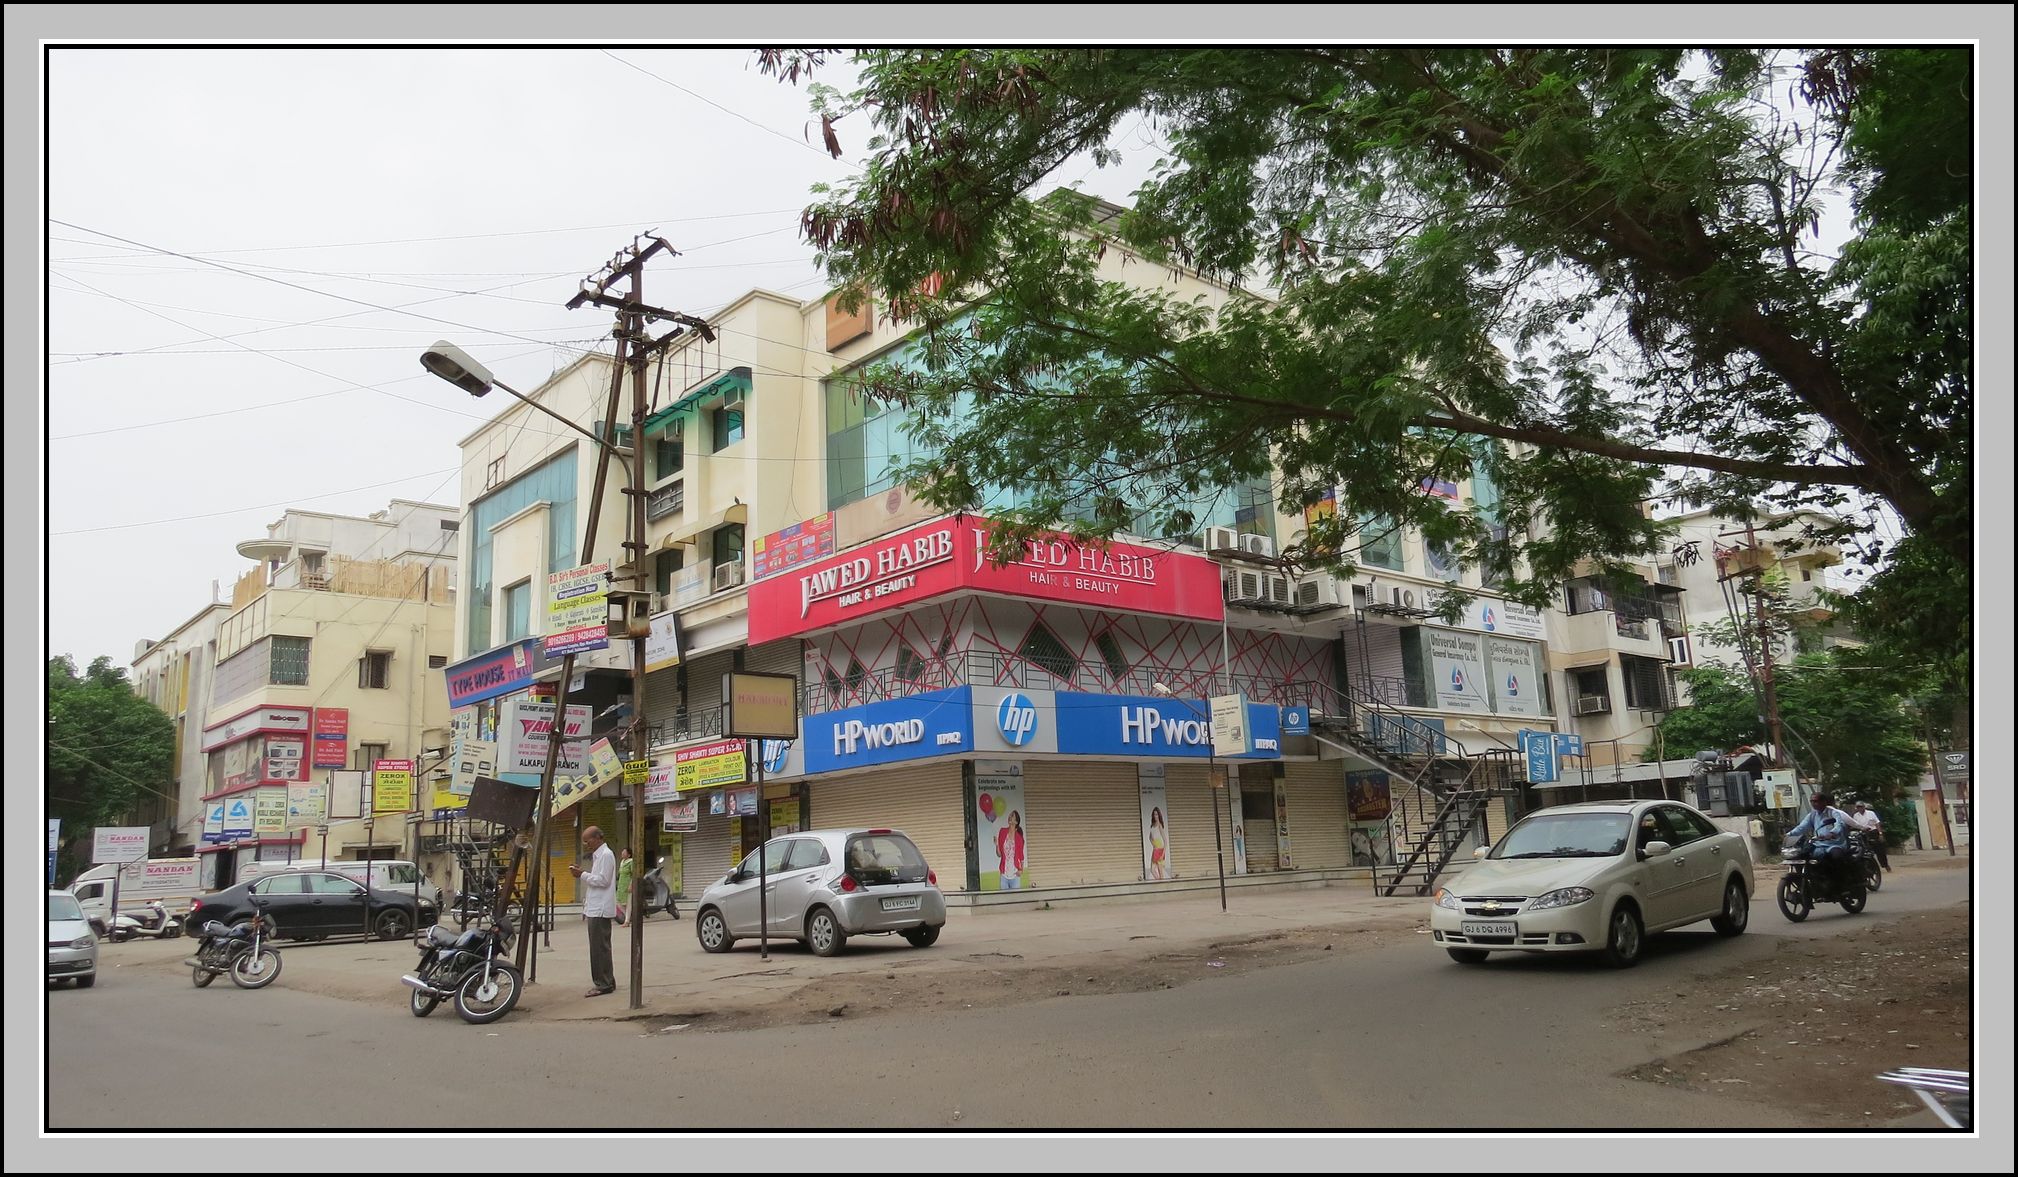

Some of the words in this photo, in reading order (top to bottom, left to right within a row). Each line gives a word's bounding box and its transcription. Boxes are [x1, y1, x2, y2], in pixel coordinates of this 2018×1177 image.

[972, 528, 1068, 573] JED
[1078, 546, 1157, 581] HABIB
[800, 558, 872, 619] JAWED
[877, 529, 954, 576] HABIB
[1029, 571, 1058, 586] HAIR
[1062, 575, 1071, 588] &
[1075, 577, 1120, 595] BEAUTY
[838, 591, 864, 608] HAIR
[864, 588, 873, 600] &
[875, 574, 917, 597] BEAUTY
[553, 599, 580, 611] Language
[580, 595, 601, 606] Classes
[1430, 633, 1457, 650] Universal
[1458, 638, 1477, 654] Sompo
[1432, 649, 1446, 658] General
[452, 675, 474, 696] TYPE
[1003, 693, 1035, 746] hp
[1121, 706, 1161, 744] HP
[1162, 718, 1214, 745] WOR
[833, 719, 863, 756] HP
[863, 718, 925, 750] WORLD
[708, 745, 726, 756] SUPER
[519, 759, 546, 768] ALKAPU
[557, 760, 580, 770] RANCH
[677, 765, 696, 776] ZEROX
[146, 865, 193, 874] NANDAN
[1464, 925, 1474, 933] GJ
[1475, 925, 1481, 933] 6
[1481, 925, 1494, 933] DQ
[1494, 926, 1513, 934] 4996
